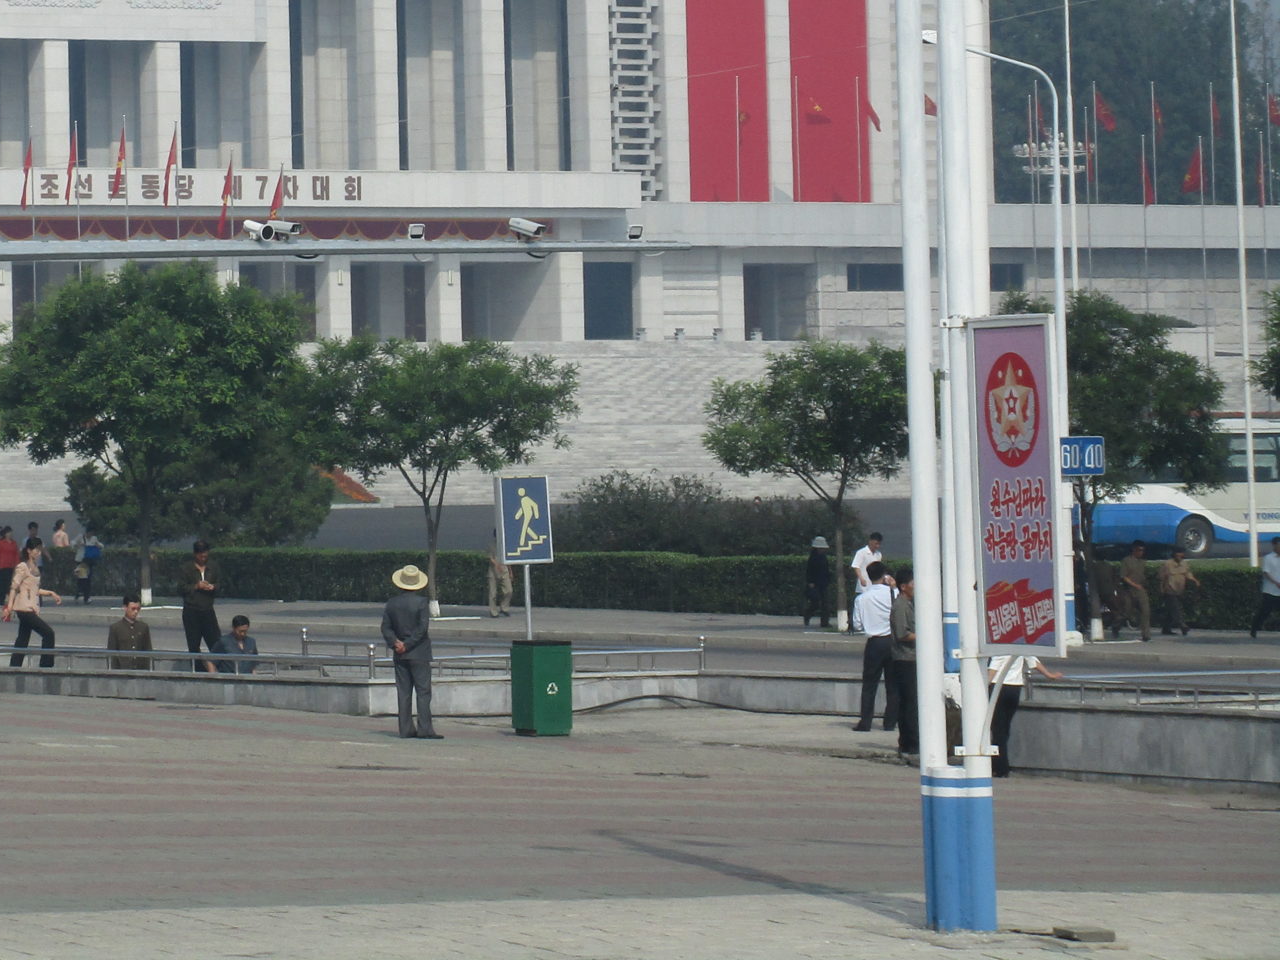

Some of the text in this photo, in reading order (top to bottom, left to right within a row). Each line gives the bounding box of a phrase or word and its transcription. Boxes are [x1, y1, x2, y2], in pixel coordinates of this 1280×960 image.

[40, 173, 195, 200] 조선로동당
[1061, 444, 1103, 469] 60 40
[1242, 512, 1280, 520] YTONG
